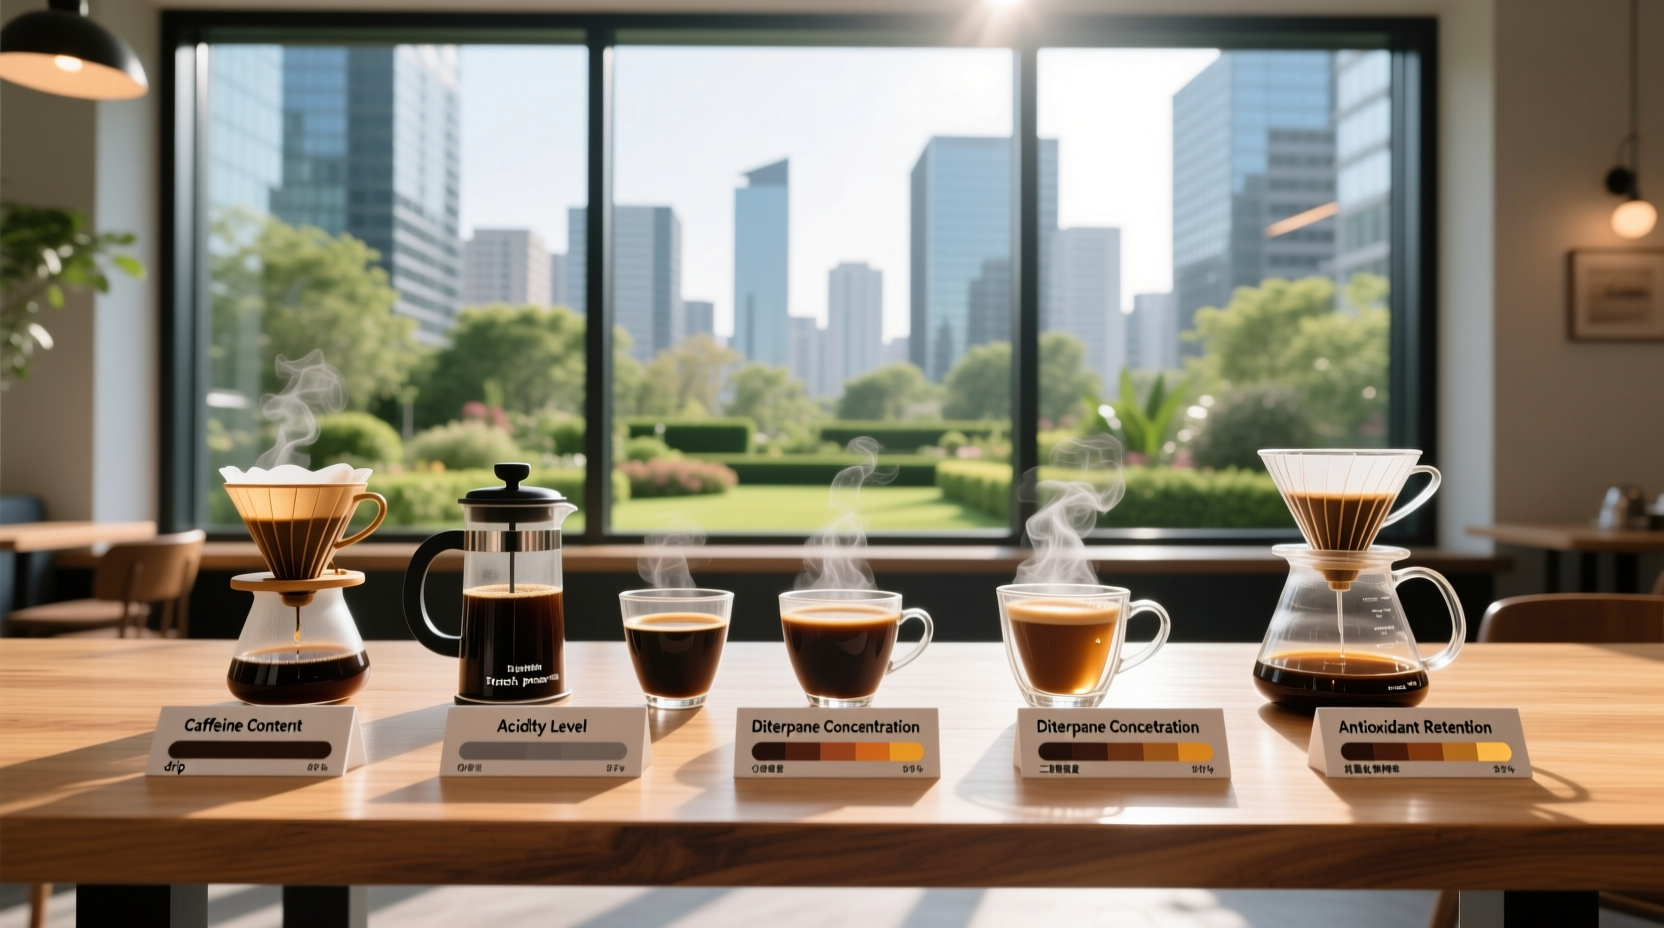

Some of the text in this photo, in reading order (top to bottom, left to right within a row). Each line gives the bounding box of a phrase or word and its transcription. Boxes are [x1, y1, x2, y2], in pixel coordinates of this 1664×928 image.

[185, 717, 303, 733] Caffeine Content
[551, 718, 588, 734] Level
[752, 719, 920, 738] Diterpane Concentration
[1037, 719, 1200, 738] Diterpane Concetration
[1339, 719, 1493, 735] Antioxidant Retention
[164, 759, 186, 775] drip
